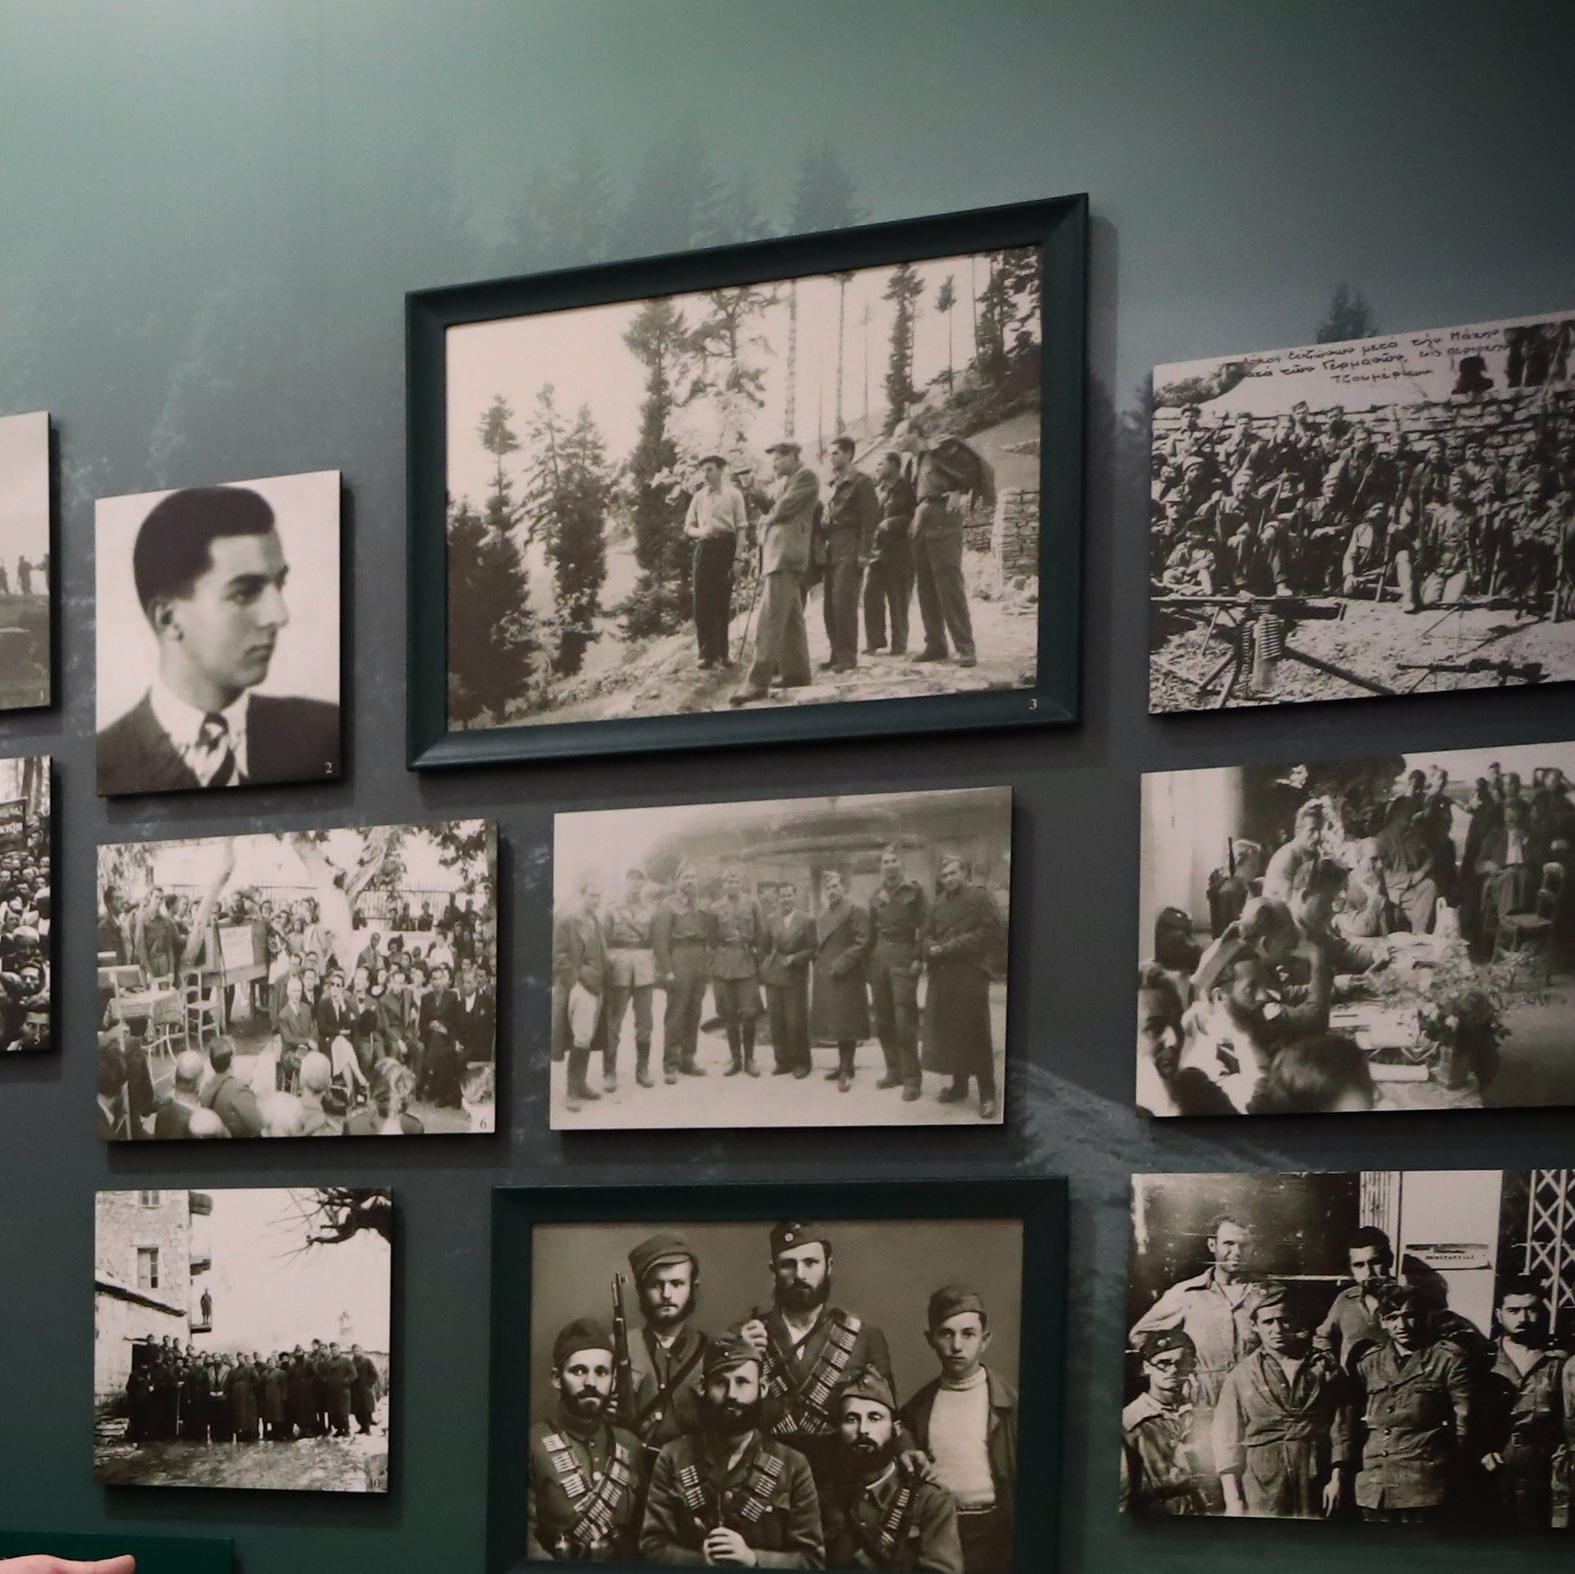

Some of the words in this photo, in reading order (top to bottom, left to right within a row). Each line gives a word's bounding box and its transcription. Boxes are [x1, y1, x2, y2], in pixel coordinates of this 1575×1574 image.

[1028, 698, 1038, 711] 3
[326, 761, 333, 774] 2
[479, 1118, 487, 1129] 6
